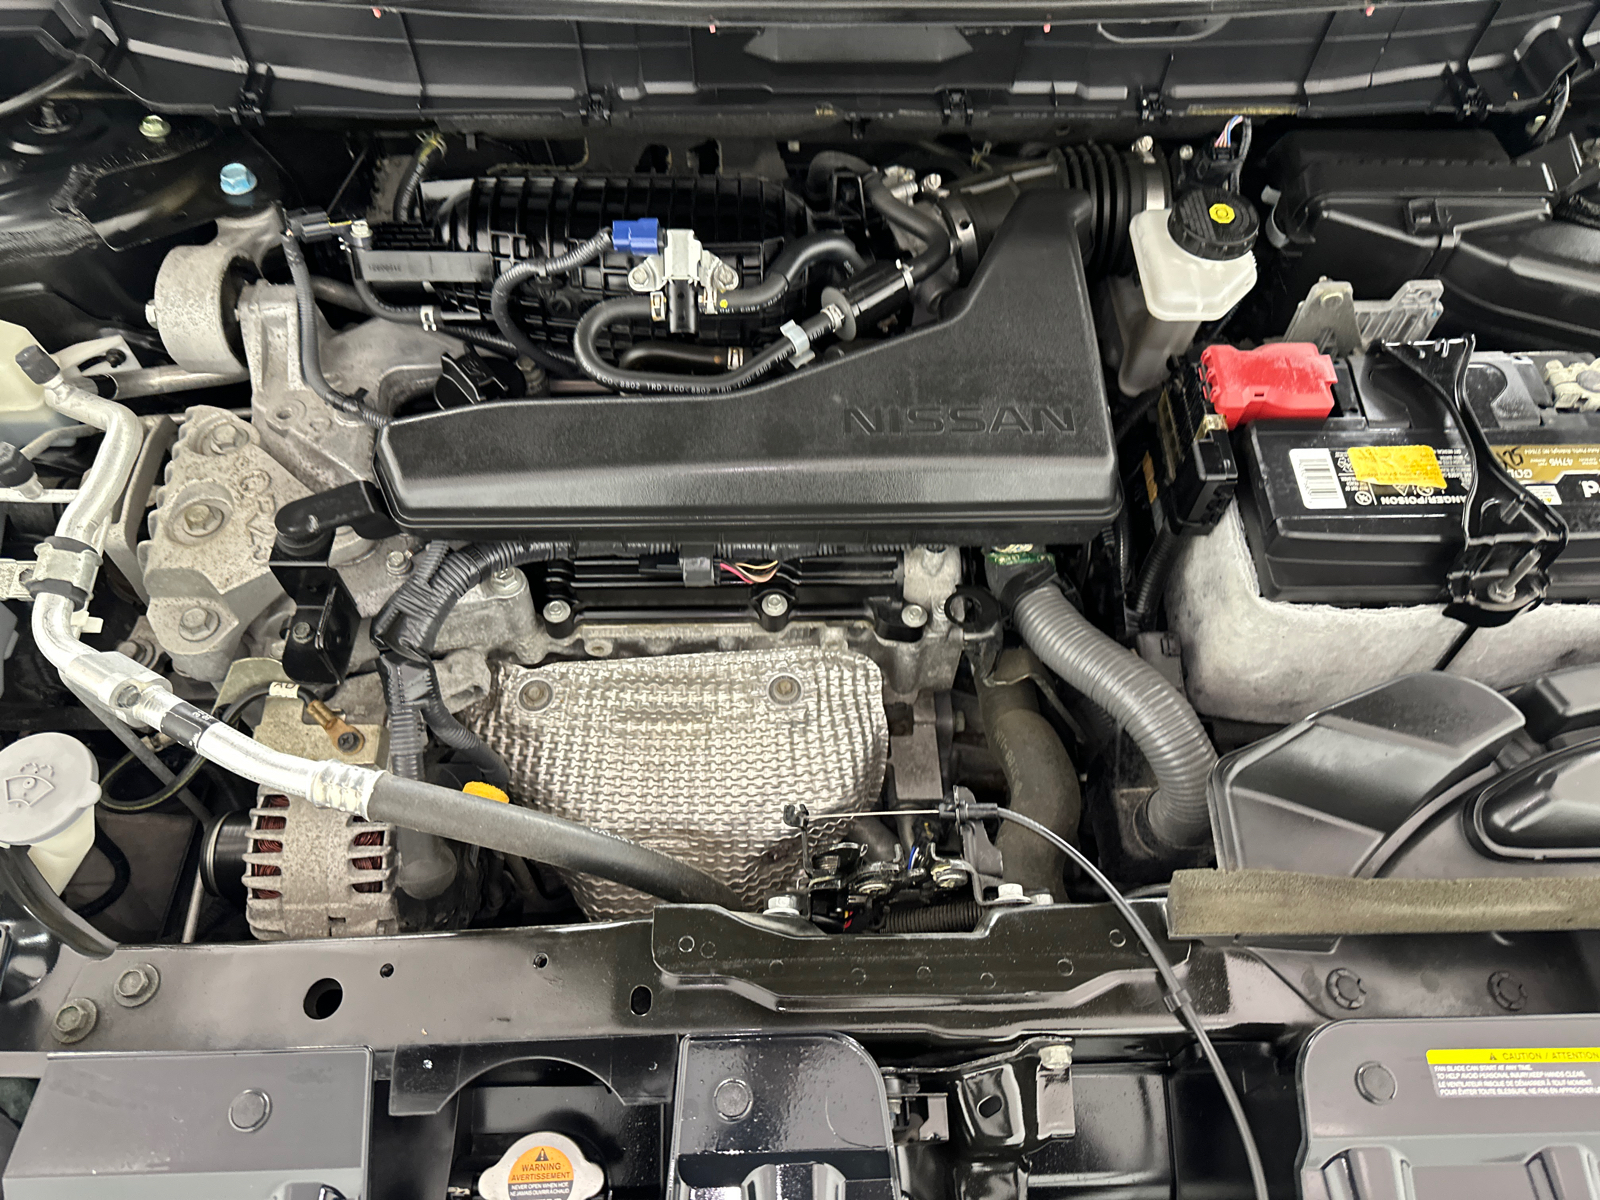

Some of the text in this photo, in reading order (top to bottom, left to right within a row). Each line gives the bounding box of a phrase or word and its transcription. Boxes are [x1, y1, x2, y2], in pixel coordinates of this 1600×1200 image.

[843, 404, 1076, 436] NISSAN
[1506, 468, 1533, 479] GOL
[1380, 495, 1467, 505] ANGER/POISON
[1502, 1052, 1542, 1061] CAUTION
[1552, 1051, 1600, 1060] ATTENTION
[521, 1162, 562, 1172] WARNING
[511, 1171, 571, 1181] AVERTISSEMENT
